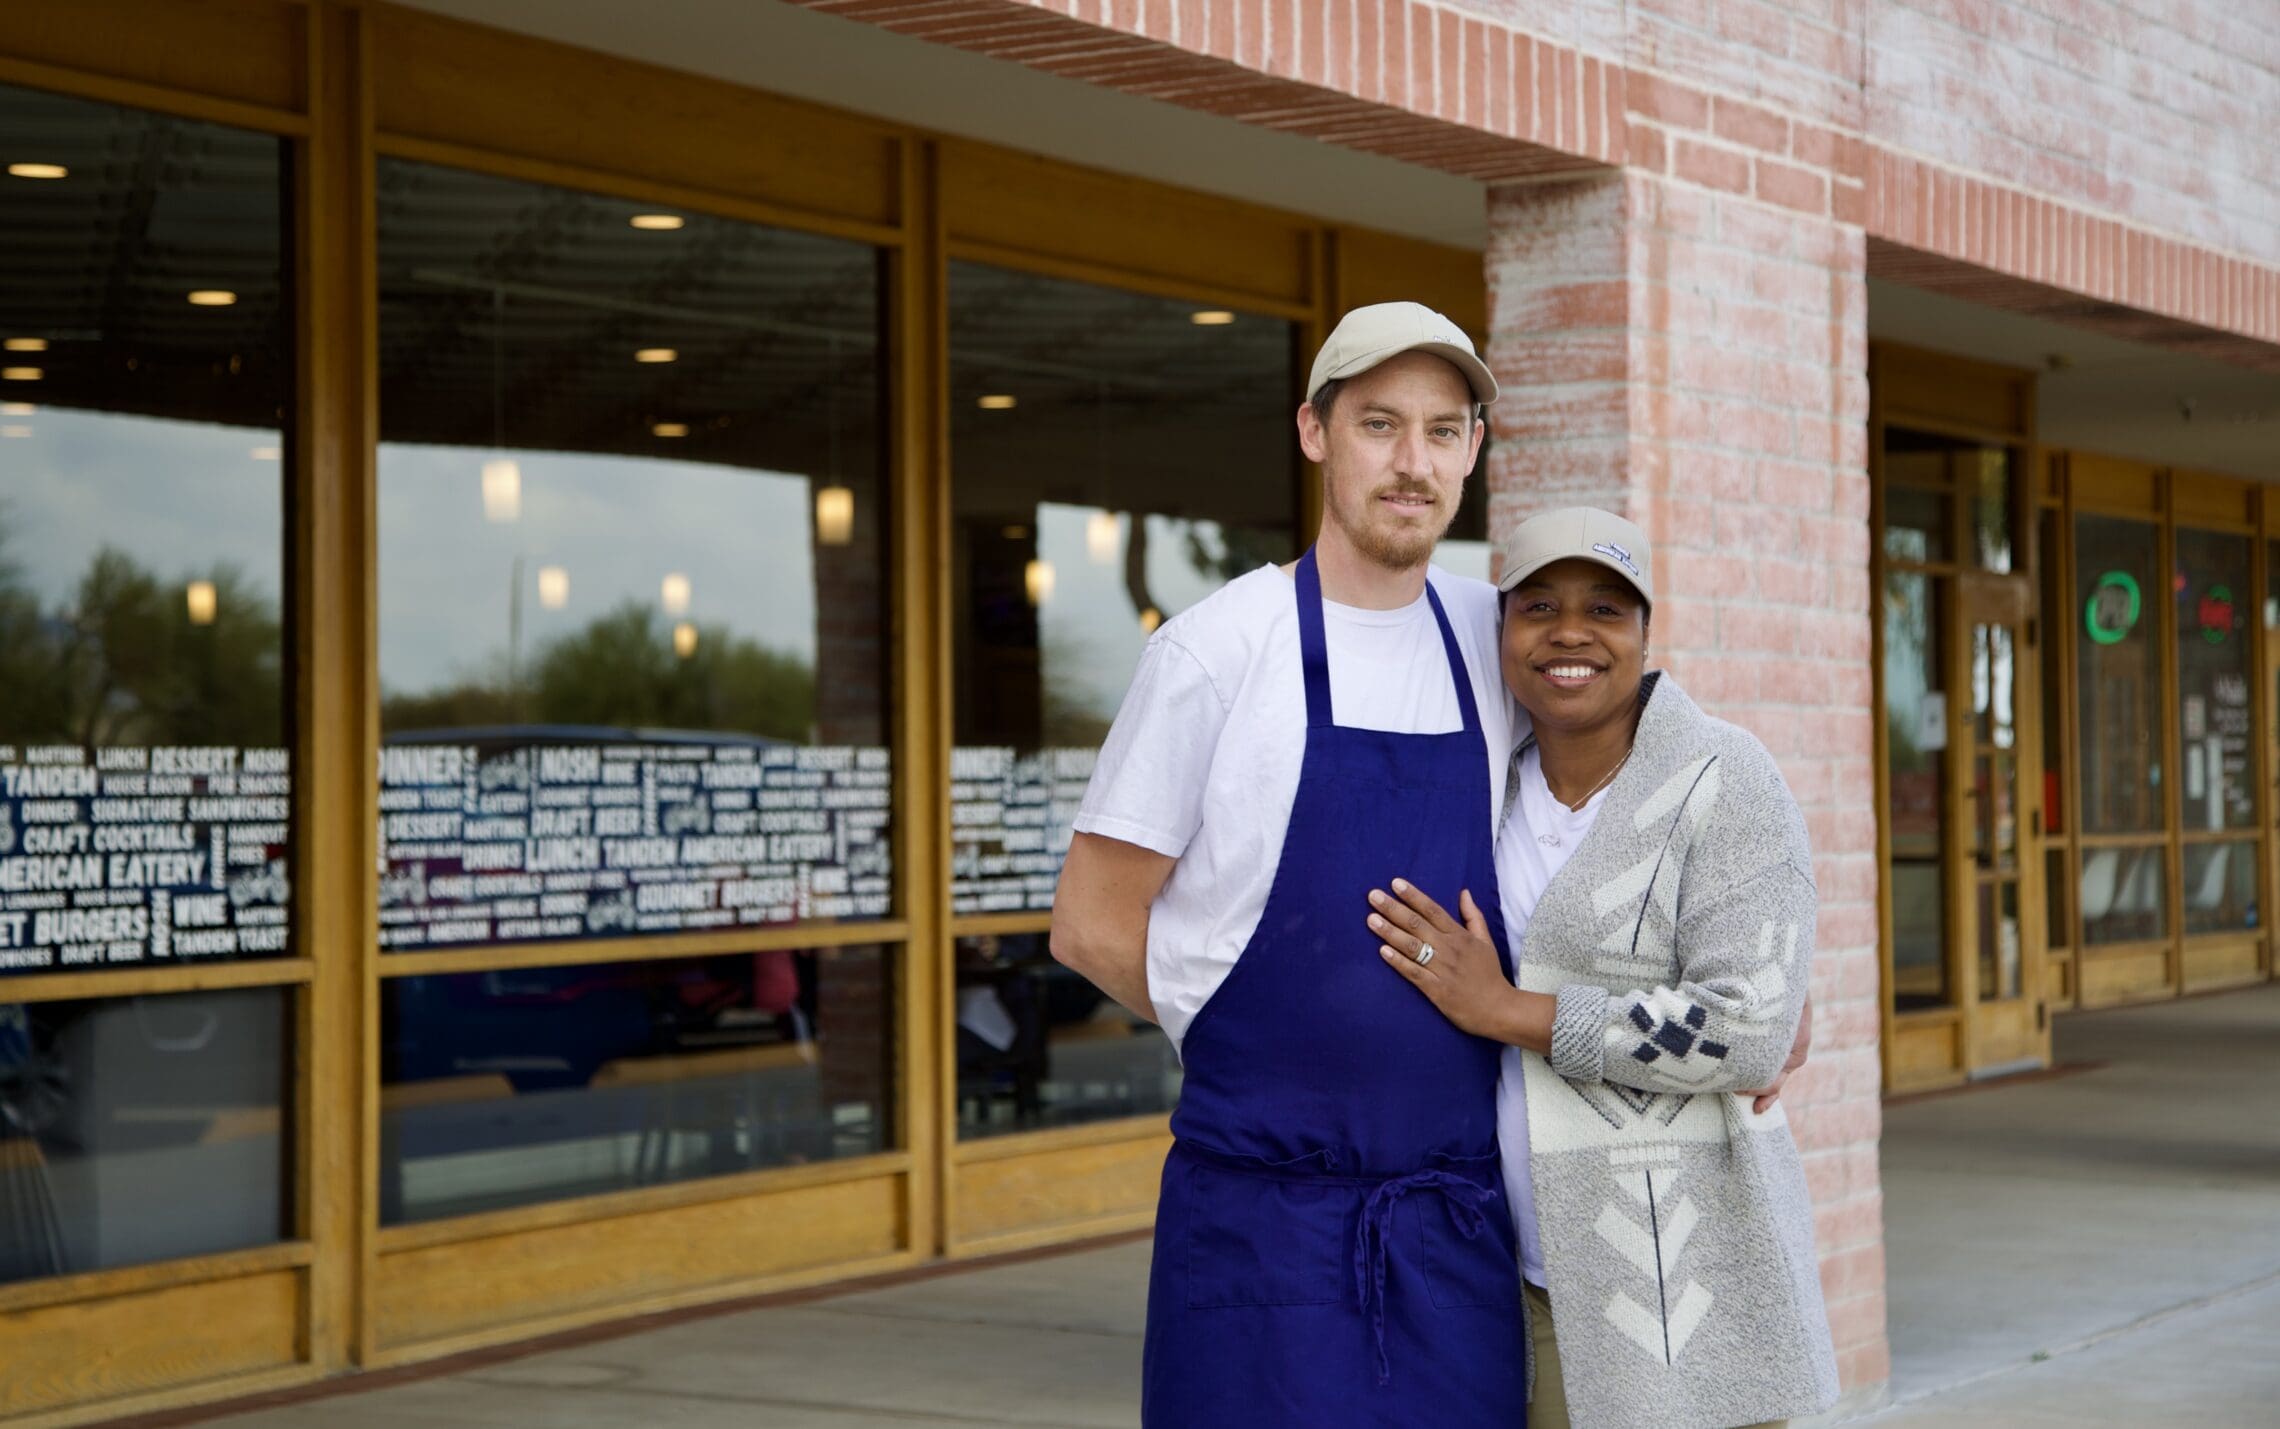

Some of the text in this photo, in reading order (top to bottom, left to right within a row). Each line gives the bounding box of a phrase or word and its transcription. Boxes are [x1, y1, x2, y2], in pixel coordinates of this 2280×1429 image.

[96, 747, 146, 769] LUNCH
[151, 747, 237, 776] DESSERT
[243, 748, 289, 773] NOSH
[540, 746, 600, 784] NOSH
[2, 764, 98, 797] TANDEM
[103, 774, 146, 796] HOUSE
[207, 774, 289, 796] PUB SNACKS
[21, 801, 79, 824] DINNER
[90, 796, 289, 823] SIGNATURE SANDWICHES
[530, 808, 640, 838] DRAFT BEER
[23, 822, 195, 854] CRAFT COCKTAILS
[387, 813, 463, 841] DESSERT
[462, 841, 521, 872] DRINKS
[524, 837, 601, 872] LUNCH
[602, 837, 679, 869] TANDEM
[680, 834, 768, 865] AMERICAN
[768, 832, 834, 861] EATERY
[108, 852, 206, 889] EATERY
[34, 905, 150, 946] BURGERS
[173, 893, 228, 928] WINE
[61, 940, 144, 965] DRAFT BEER
[172, 925, 288, 957] TANDEM TOAST
